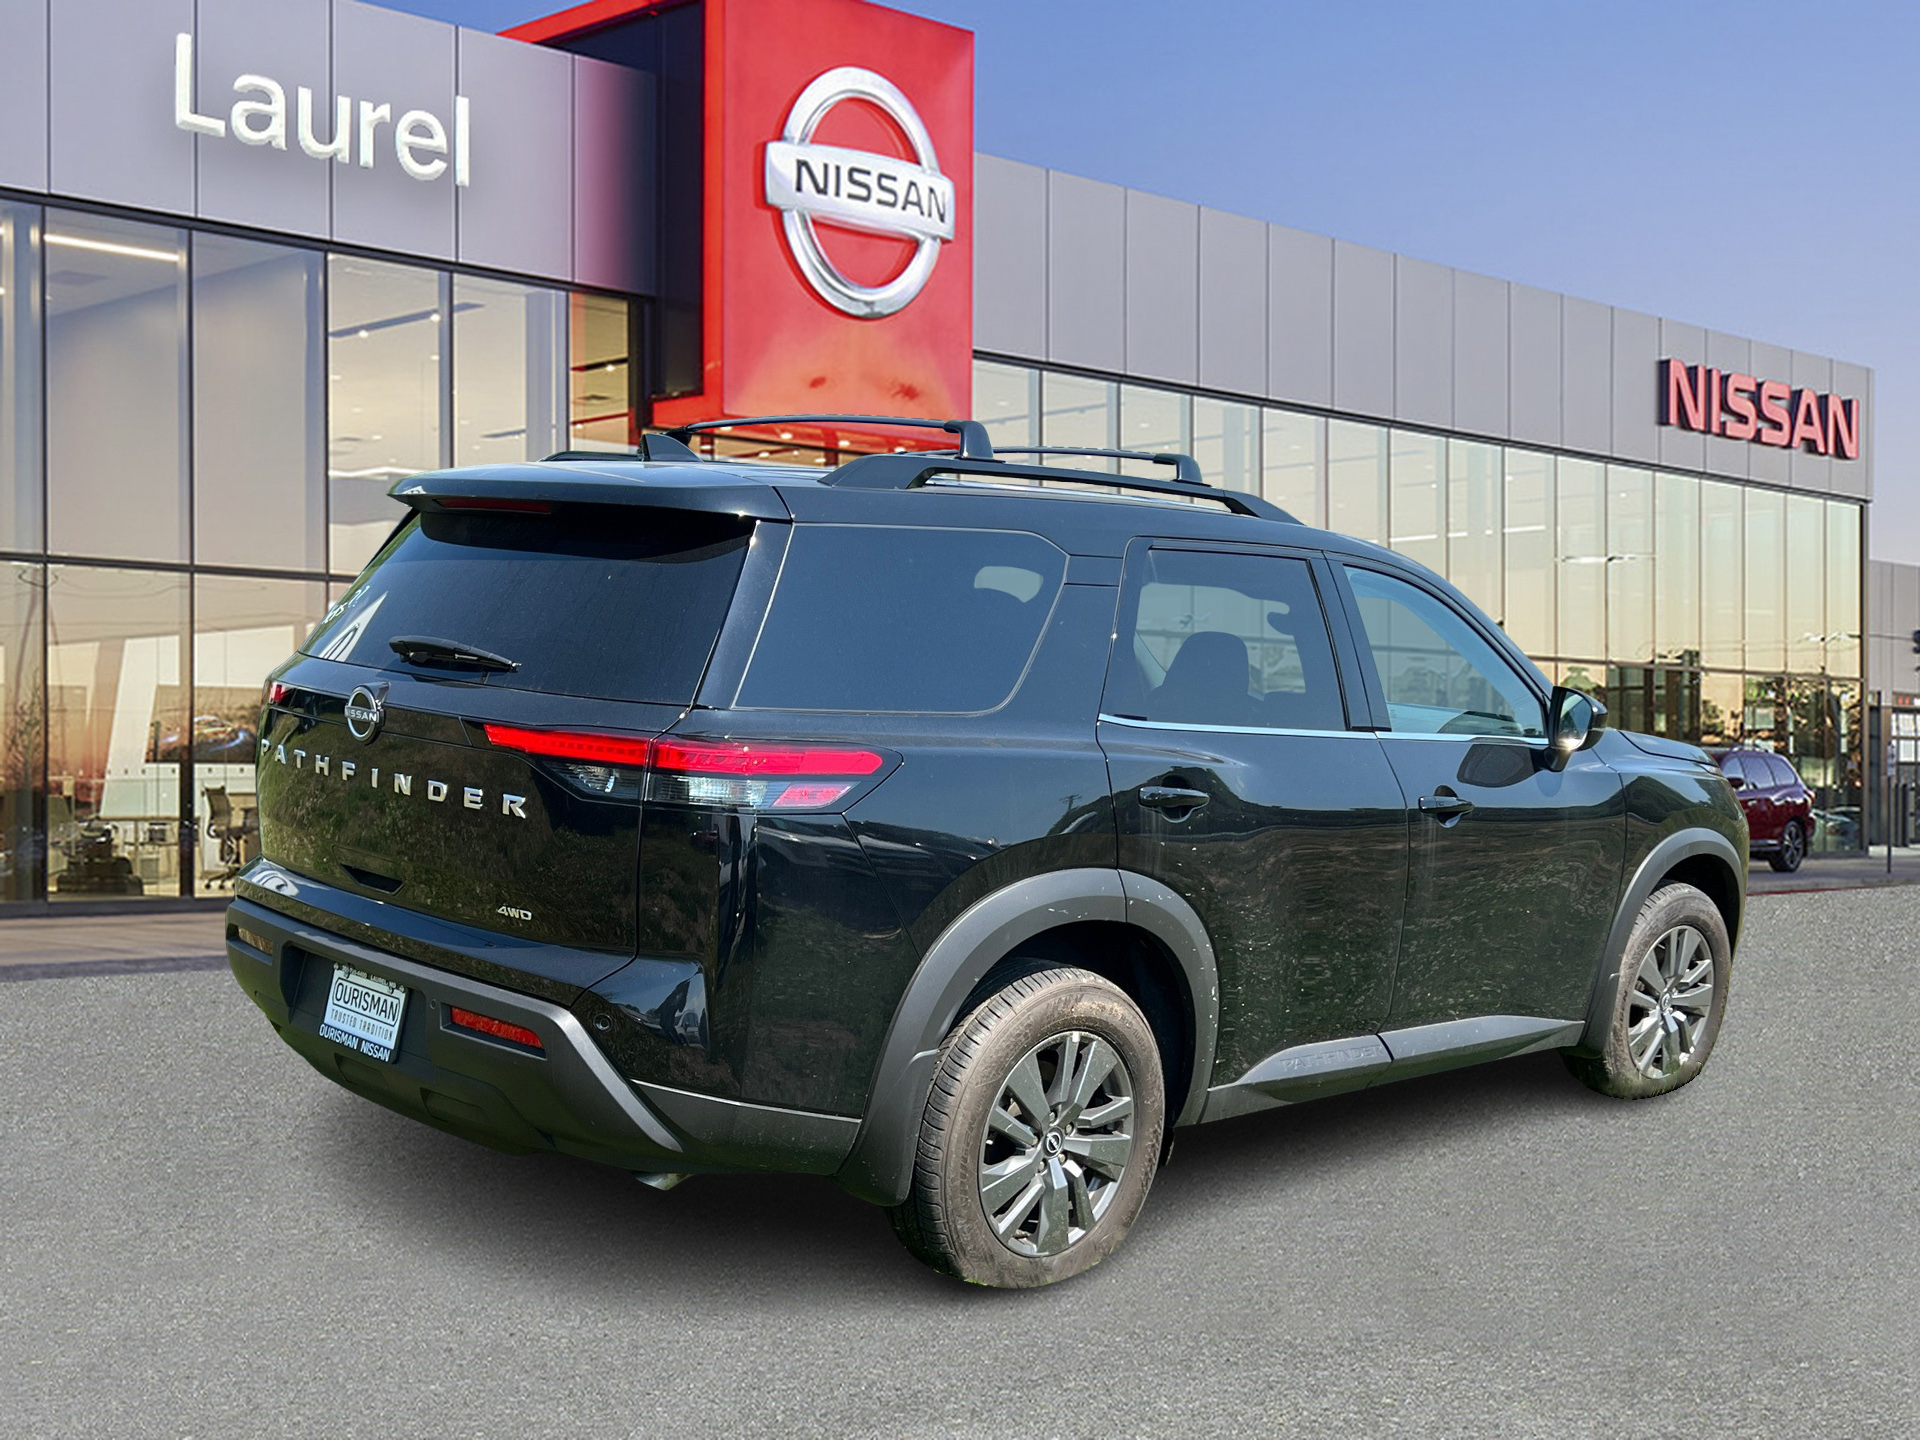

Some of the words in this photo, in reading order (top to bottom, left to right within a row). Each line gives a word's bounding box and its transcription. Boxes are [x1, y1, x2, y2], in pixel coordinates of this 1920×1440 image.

[175, 32, 470, 188] Laurel
[795, 158, 946, 224] NISSAN
[1657, 357, 1860, 461] NISSAN
[260, 738, 526, 819] PATHFINDER
[496, 905, 533, 921] 4WD
[334, 982, 398, 1022] OURISMAN
[319, 1023, 359, 1050] OURISMAN
[360, 1040, 391, 1062] NISSAN
[330, 1008, 358, 1029] TRUSTED
[359, 1019, 394, 1042] TRADITION
[1280, 1044, 1383, 1072] PATHFINDER
